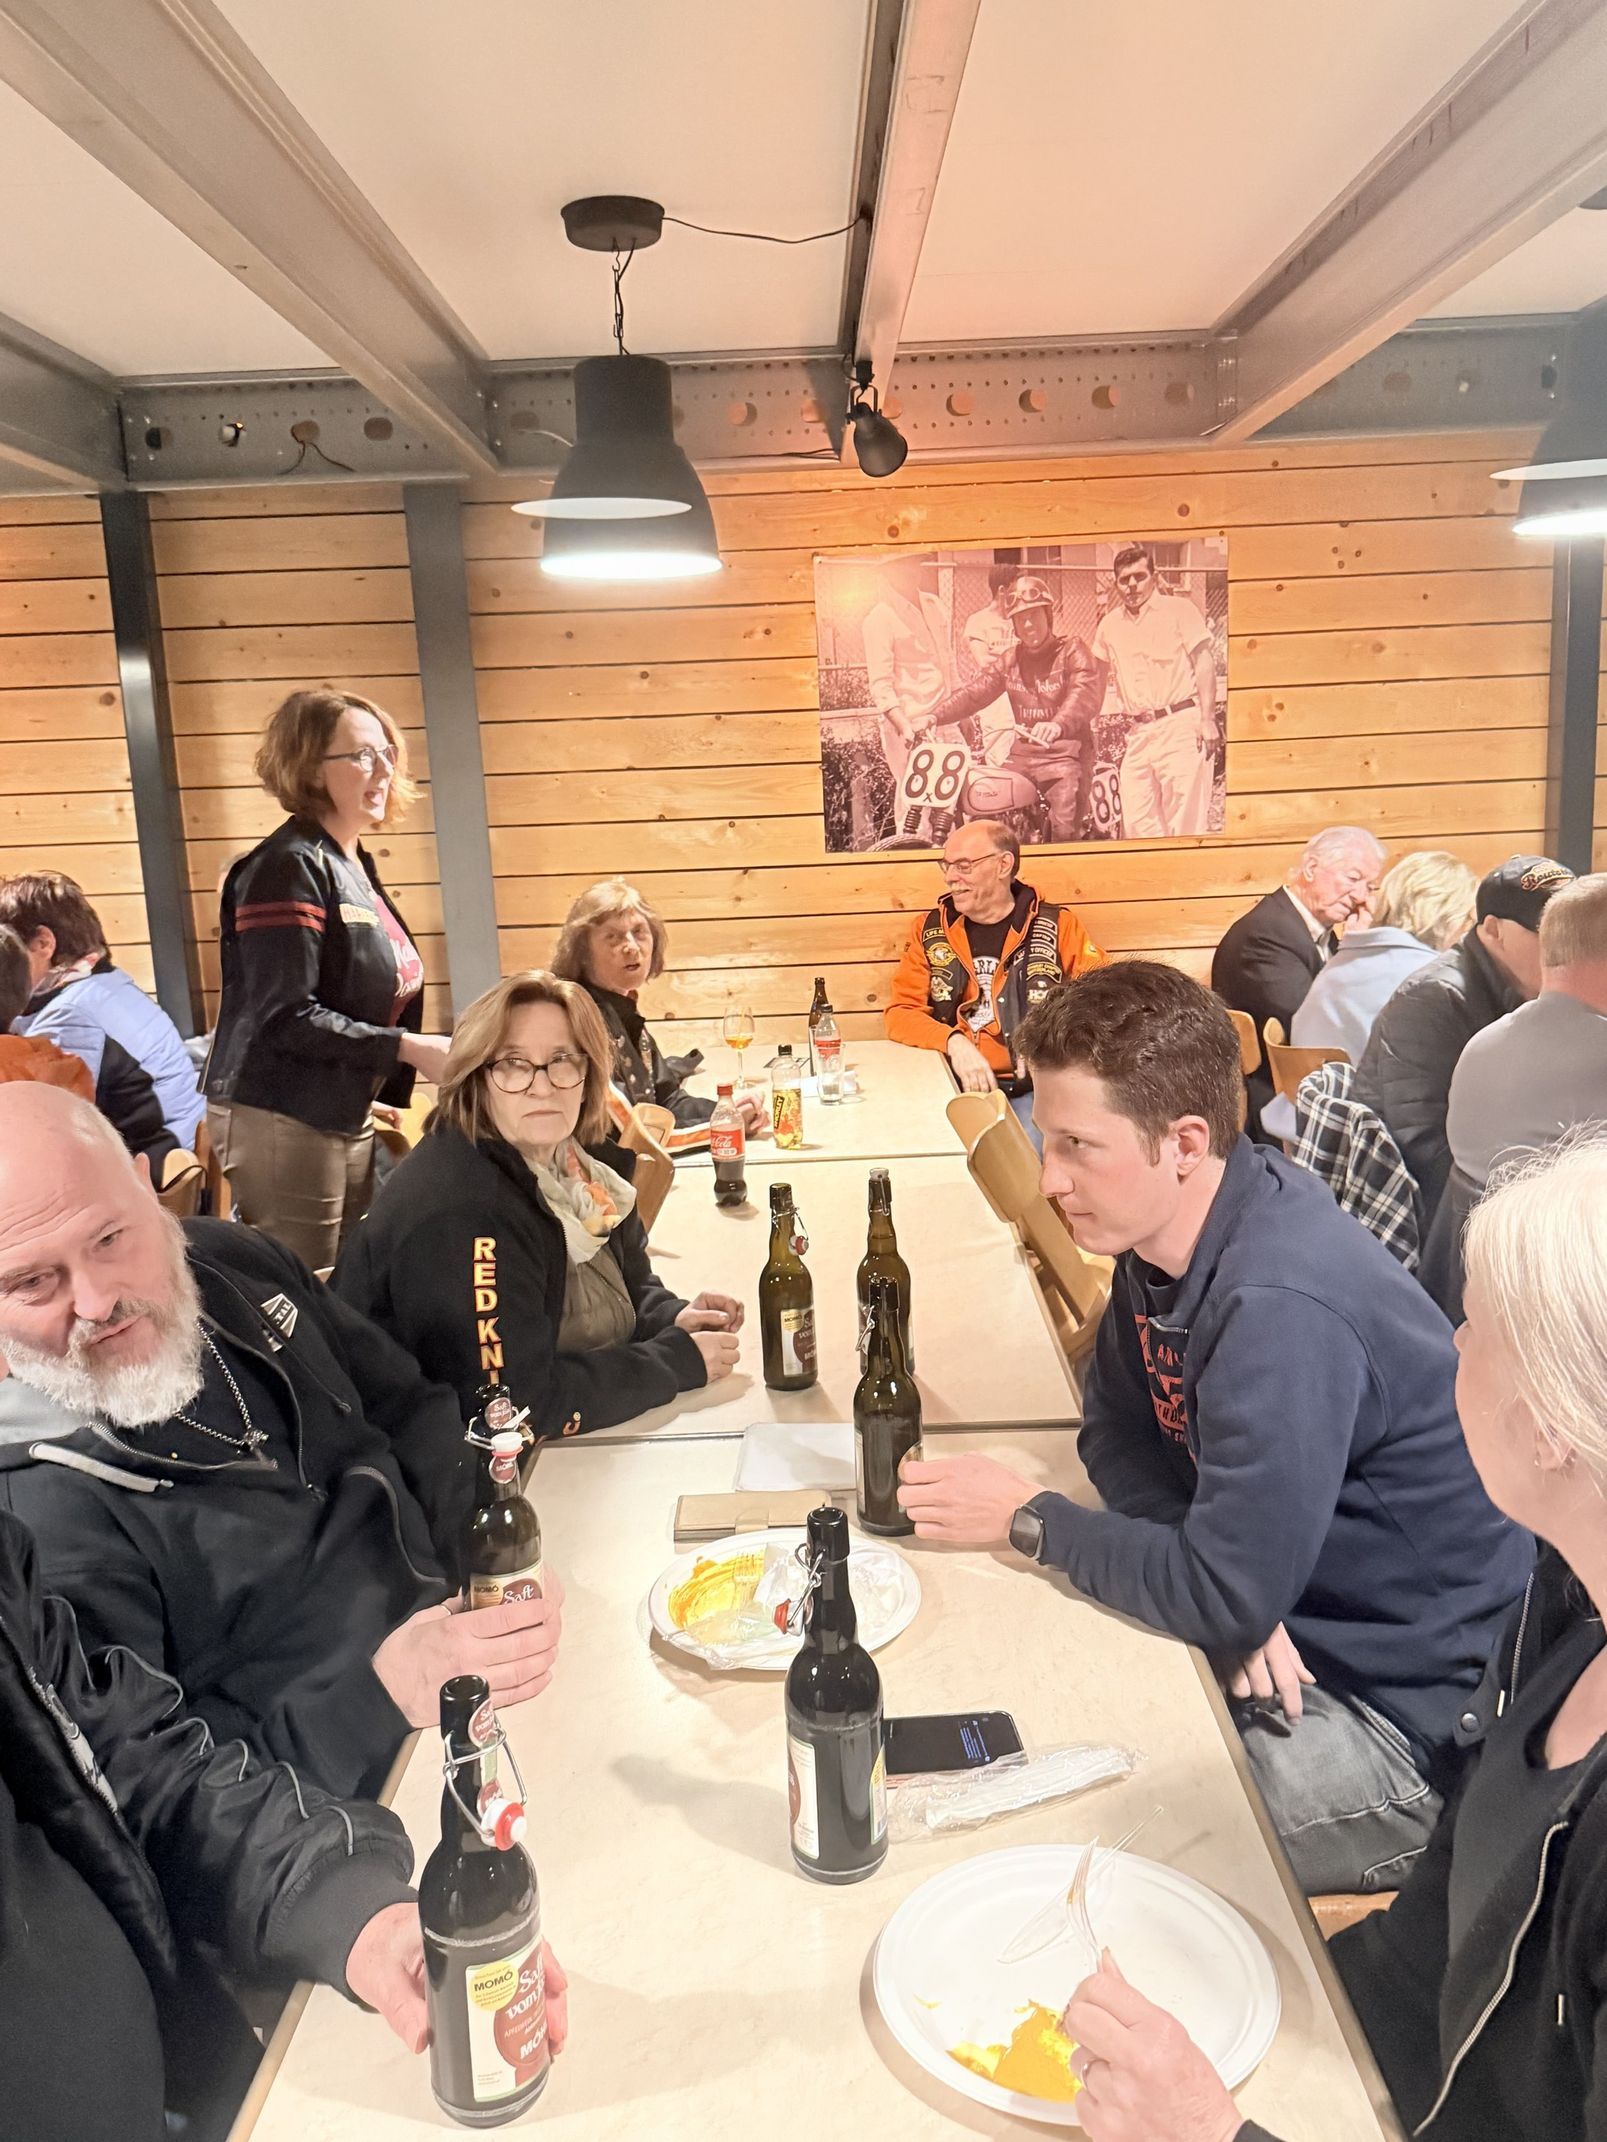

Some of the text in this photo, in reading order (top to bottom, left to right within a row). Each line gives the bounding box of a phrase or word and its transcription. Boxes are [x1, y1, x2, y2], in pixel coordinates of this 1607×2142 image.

[905, 749, 965, 801] 88
[1092, 774, 1121, 824] 88
[473, 1236, 505, 1385] RED KNI
[504, 1584, 534, 1604] Saft
